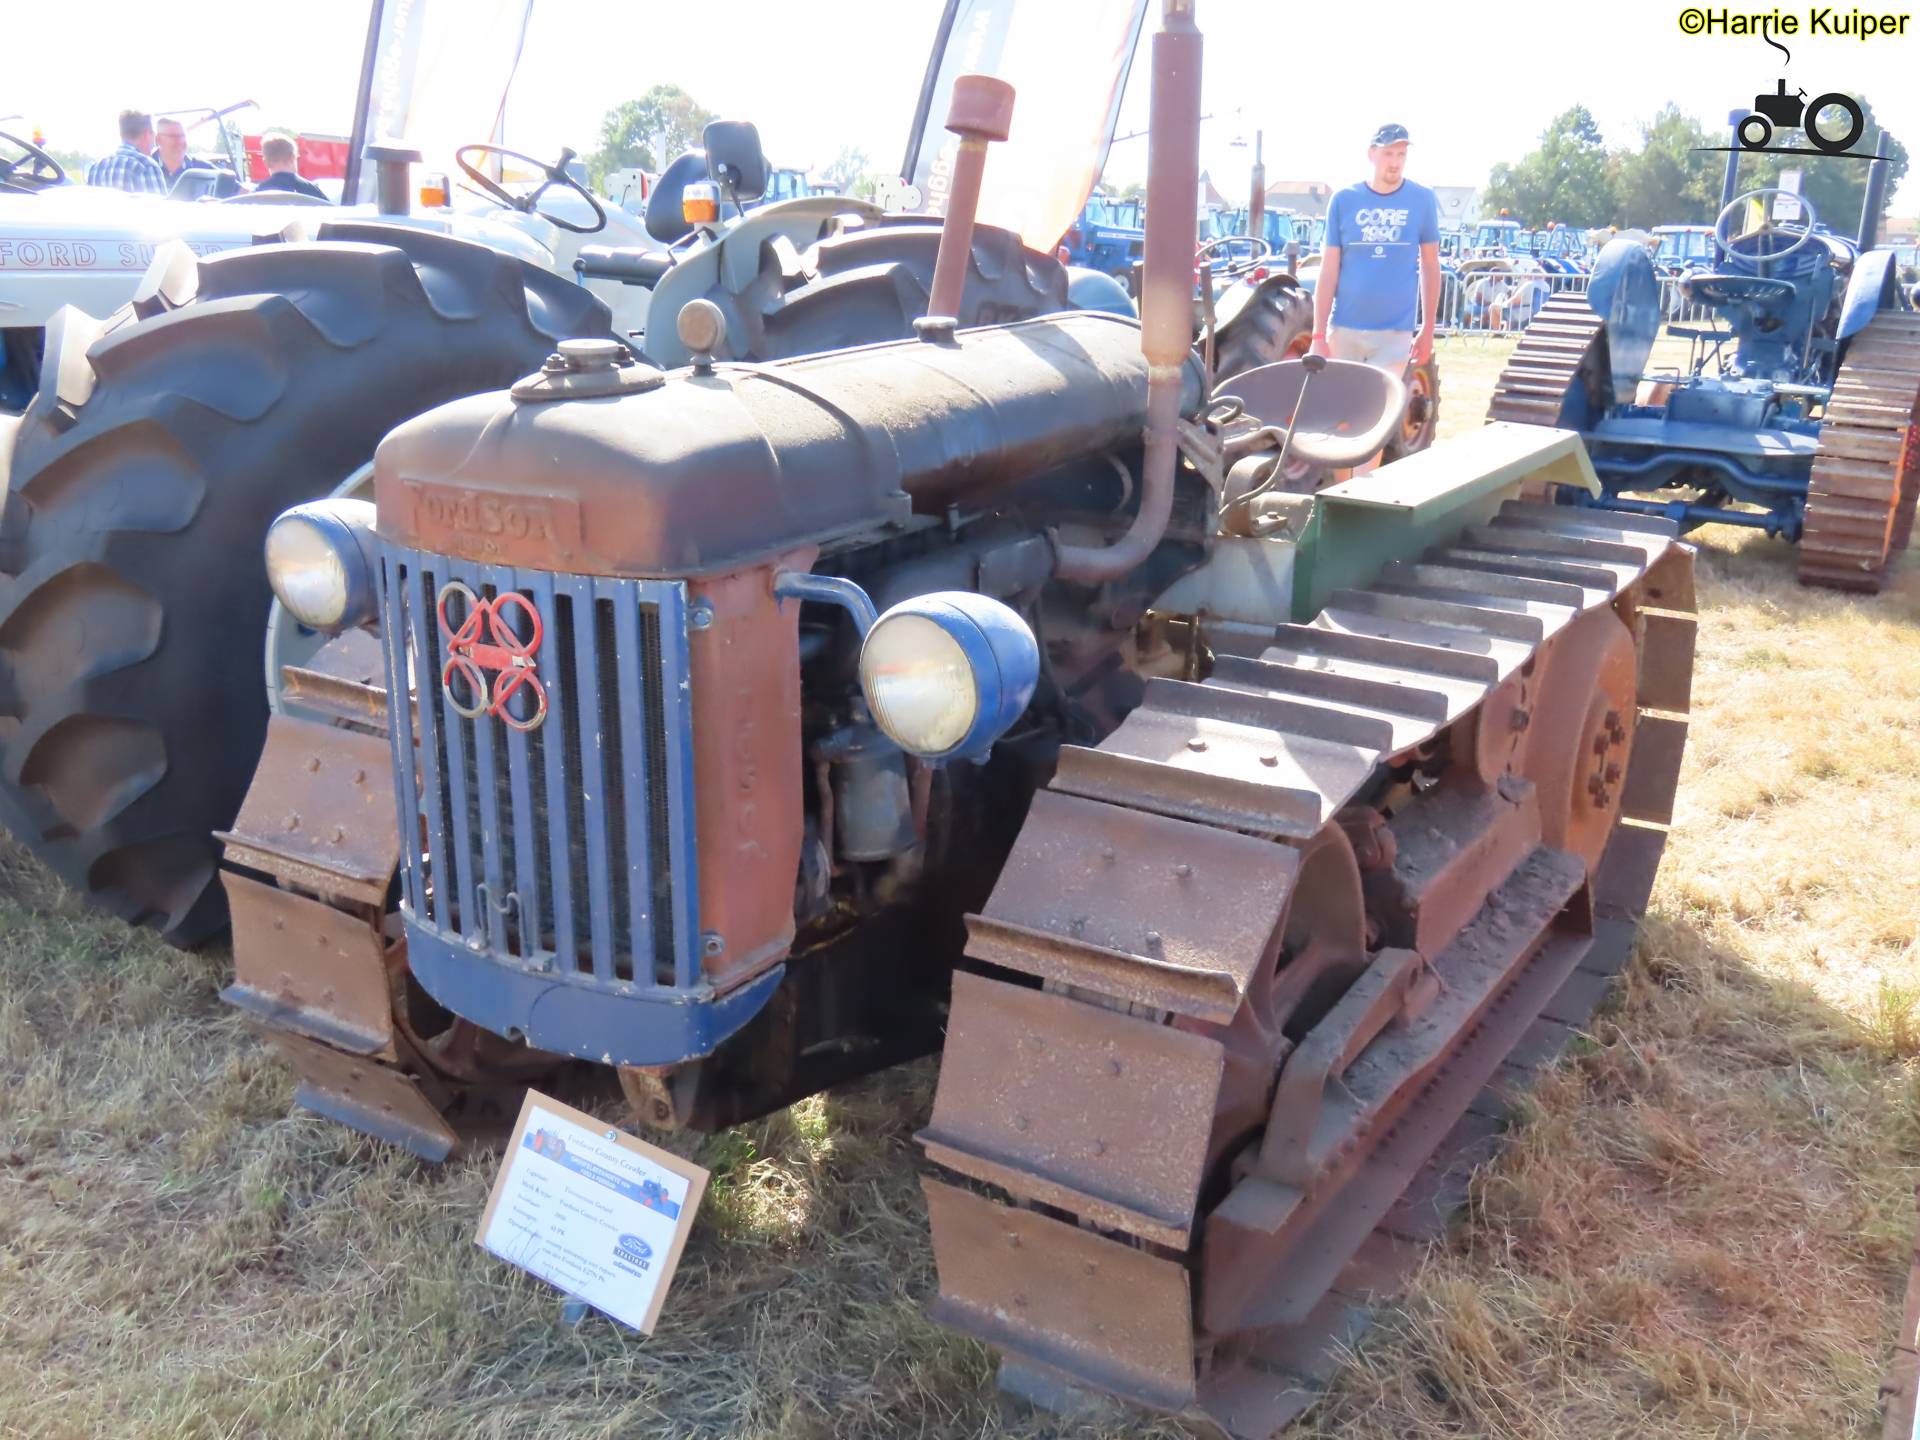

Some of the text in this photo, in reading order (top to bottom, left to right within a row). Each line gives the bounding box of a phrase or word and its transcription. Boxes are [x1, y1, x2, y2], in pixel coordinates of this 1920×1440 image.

[1356, 208, 1409, 226] CORE
[0, 242, 224, 267] FORD SUER
